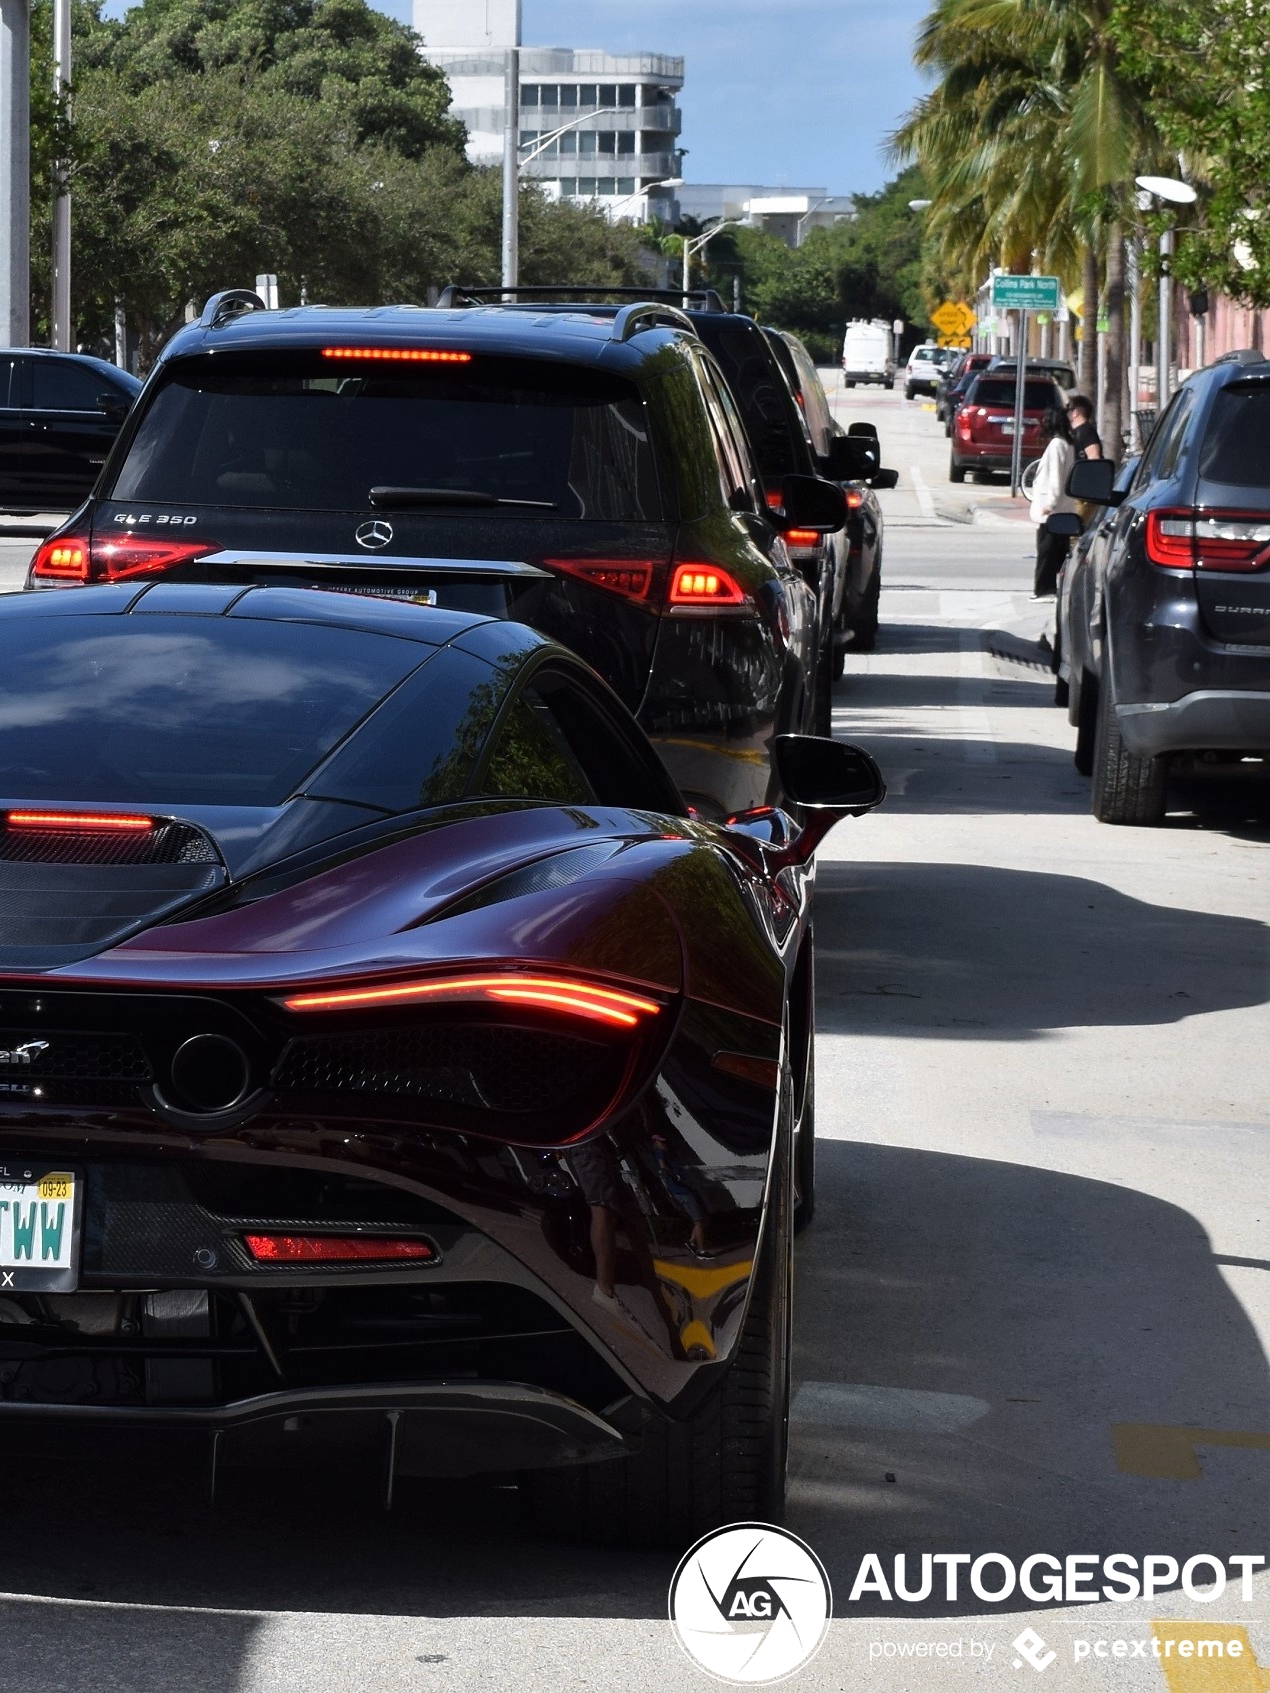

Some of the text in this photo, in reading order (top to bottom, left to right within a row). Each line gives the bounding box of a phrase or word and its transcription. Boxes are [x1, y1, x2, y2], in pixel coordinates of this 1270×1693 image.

[995, 279, 1056, 289] Collins Park North
[113, 513, 197, 525] GLE 350
[42, 1180, 67, 1197] 09-23
